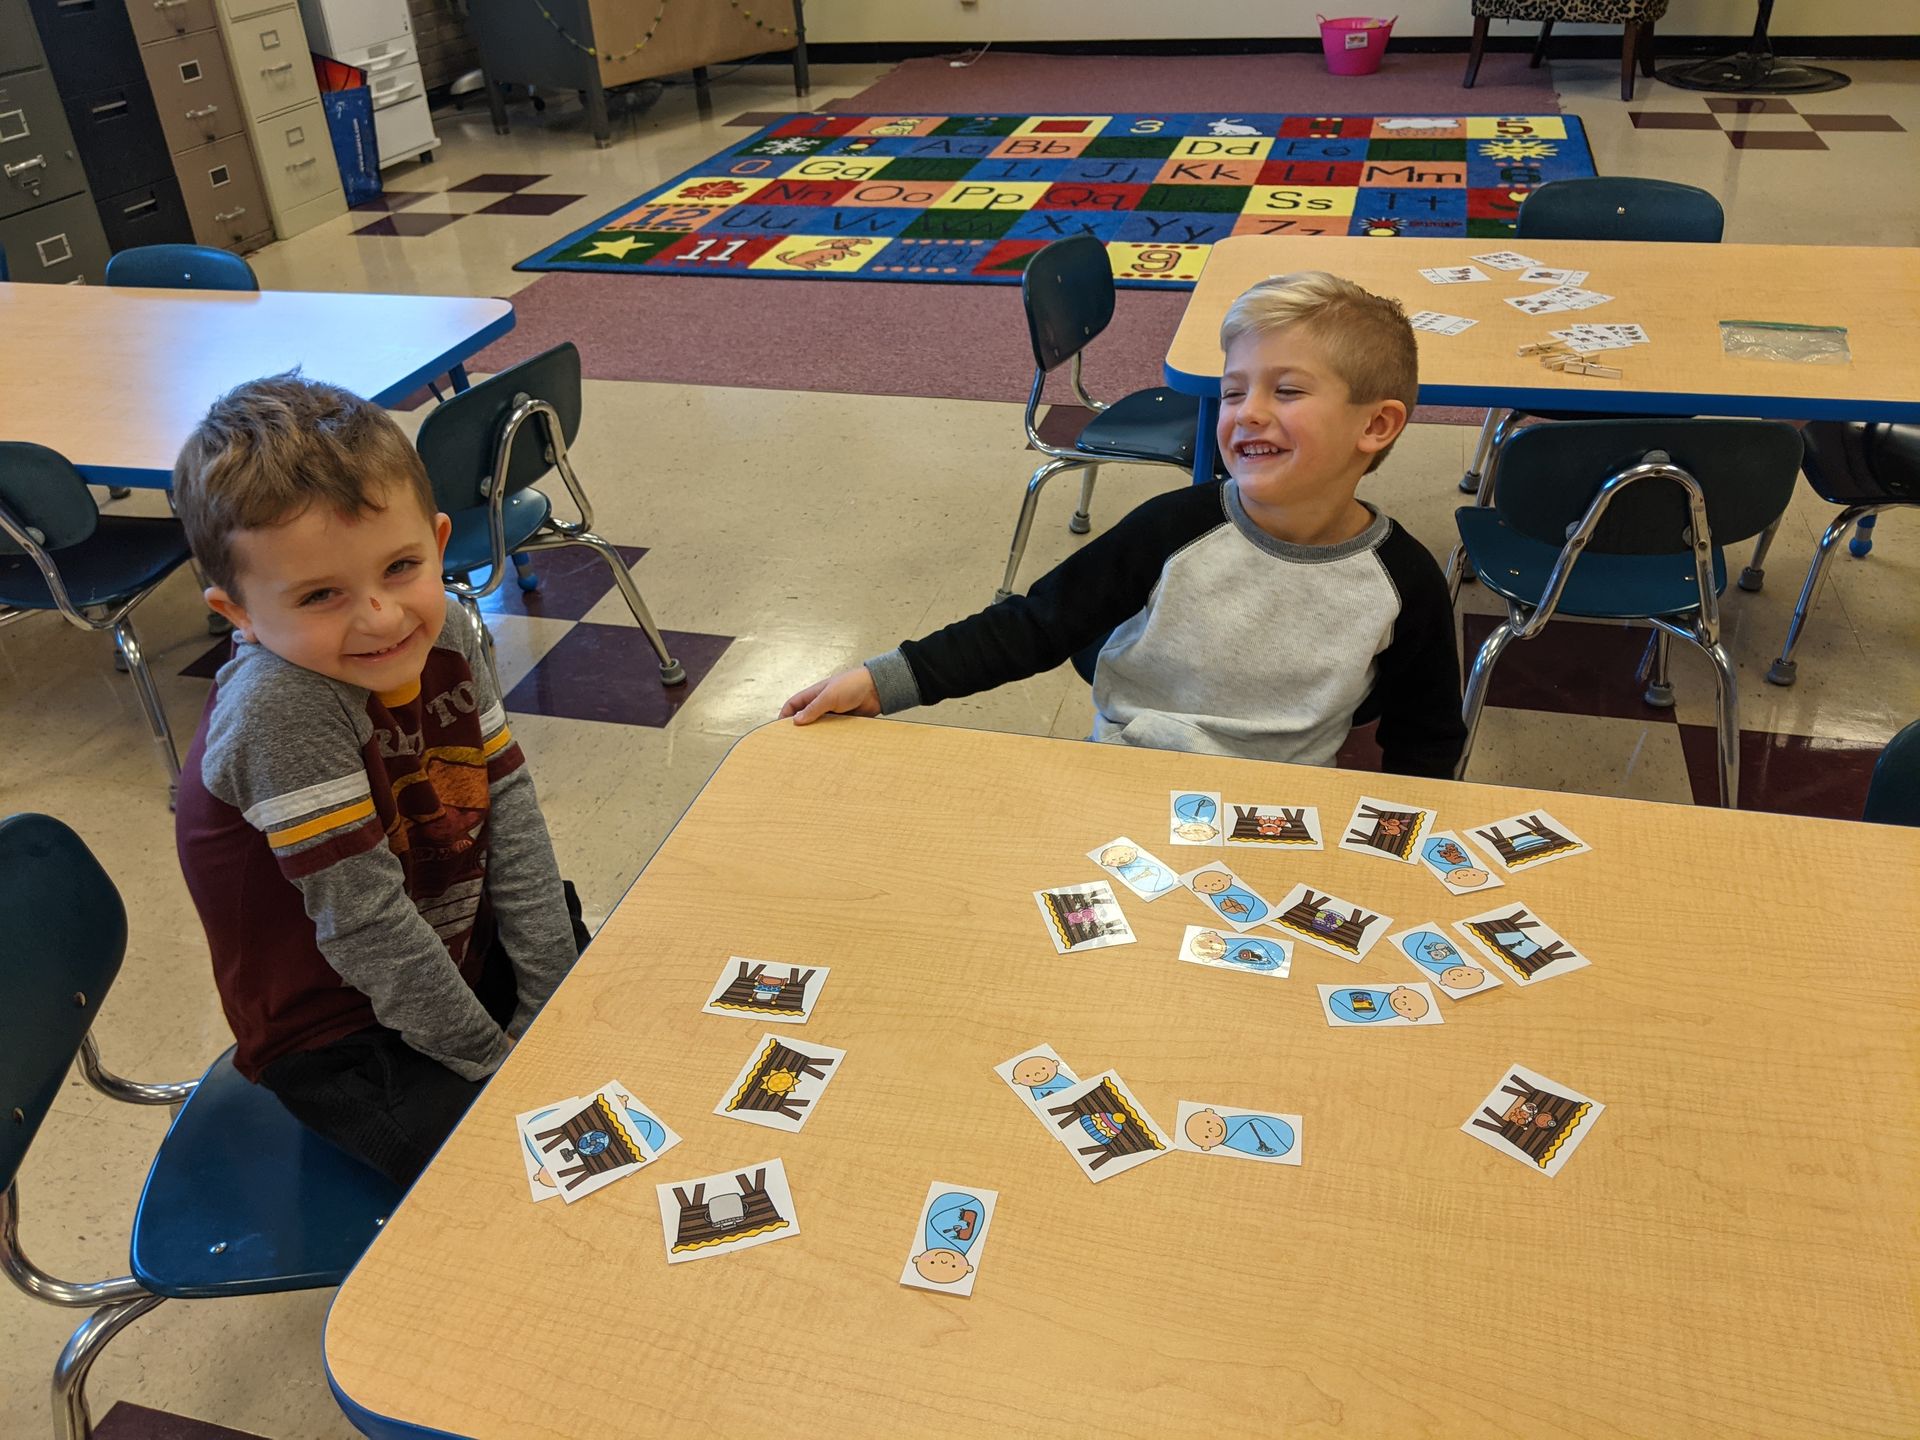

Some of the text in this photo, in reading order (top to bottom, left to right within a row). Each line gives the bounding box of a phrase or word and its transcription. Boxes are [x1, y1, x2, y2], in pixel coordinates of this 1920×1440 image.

[1130, 119, 1165, 133] 3
[1496, 120, 1534, 135] 5
[911, 139, 989, 153] Aa
[1004, 139, 1071, 155] Bb
[1186, 140, 1260, 155] Dd
[799, 160, 874, 181] Gg
[1081, 162, 1139, 183] Jj
[1170, 163, 1241, 181] Kk
[1366, 166, 1462, 183] Mm
[762, 183, 833, 200] Nn
[853, 185, 934, 202] Oo
[950, 186, 1024, 210] Pp
[1045, 187, 1130, 211] Qq
[1266, 191, 1333, 210] Ss
[624, 207, 711, 227] 12
[722, 208, 798, 229] Uu
[833, 211, 897, 231] Vv
[1027, 214, 1101, 236] Xx
[1146, 216, 1215, 243] Yy
[675, 238, 750, 262] 11
